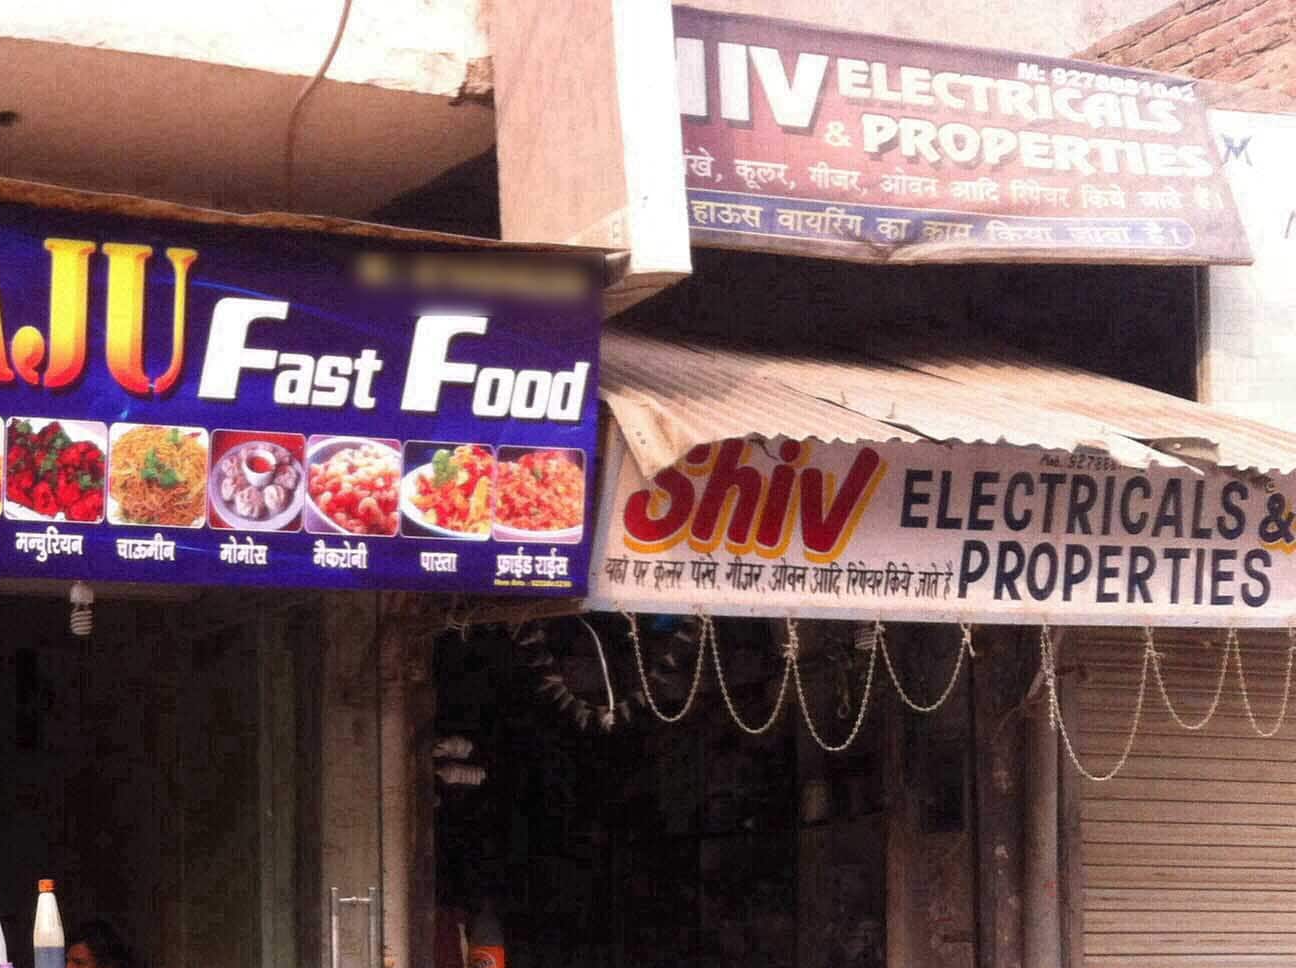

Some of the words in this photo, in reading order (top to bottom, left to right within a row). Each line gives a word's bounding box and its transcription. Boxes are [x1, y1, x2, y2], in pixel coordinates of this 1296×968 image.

[837, 57, 1183, 133] ELECTRICALS
[823, 120, 852, 147] &
[861, 113, 1213, 177] PROPERTIES
[875, 216, 912, 240] का
[198, 297, 383, 409] Fast
[400, 313, 591, 421] Food
[899, 468, 1249, 540] ELECTRICALS
[1258, 492, 1296, 543] &
[116, 532, 176, 561] चाऊमीन
[219, 535, 268, 566] मोमोस
[312, 539, 369, 569] मैकरोनी
[957, 540, 1273, 608] PROPERTIES
